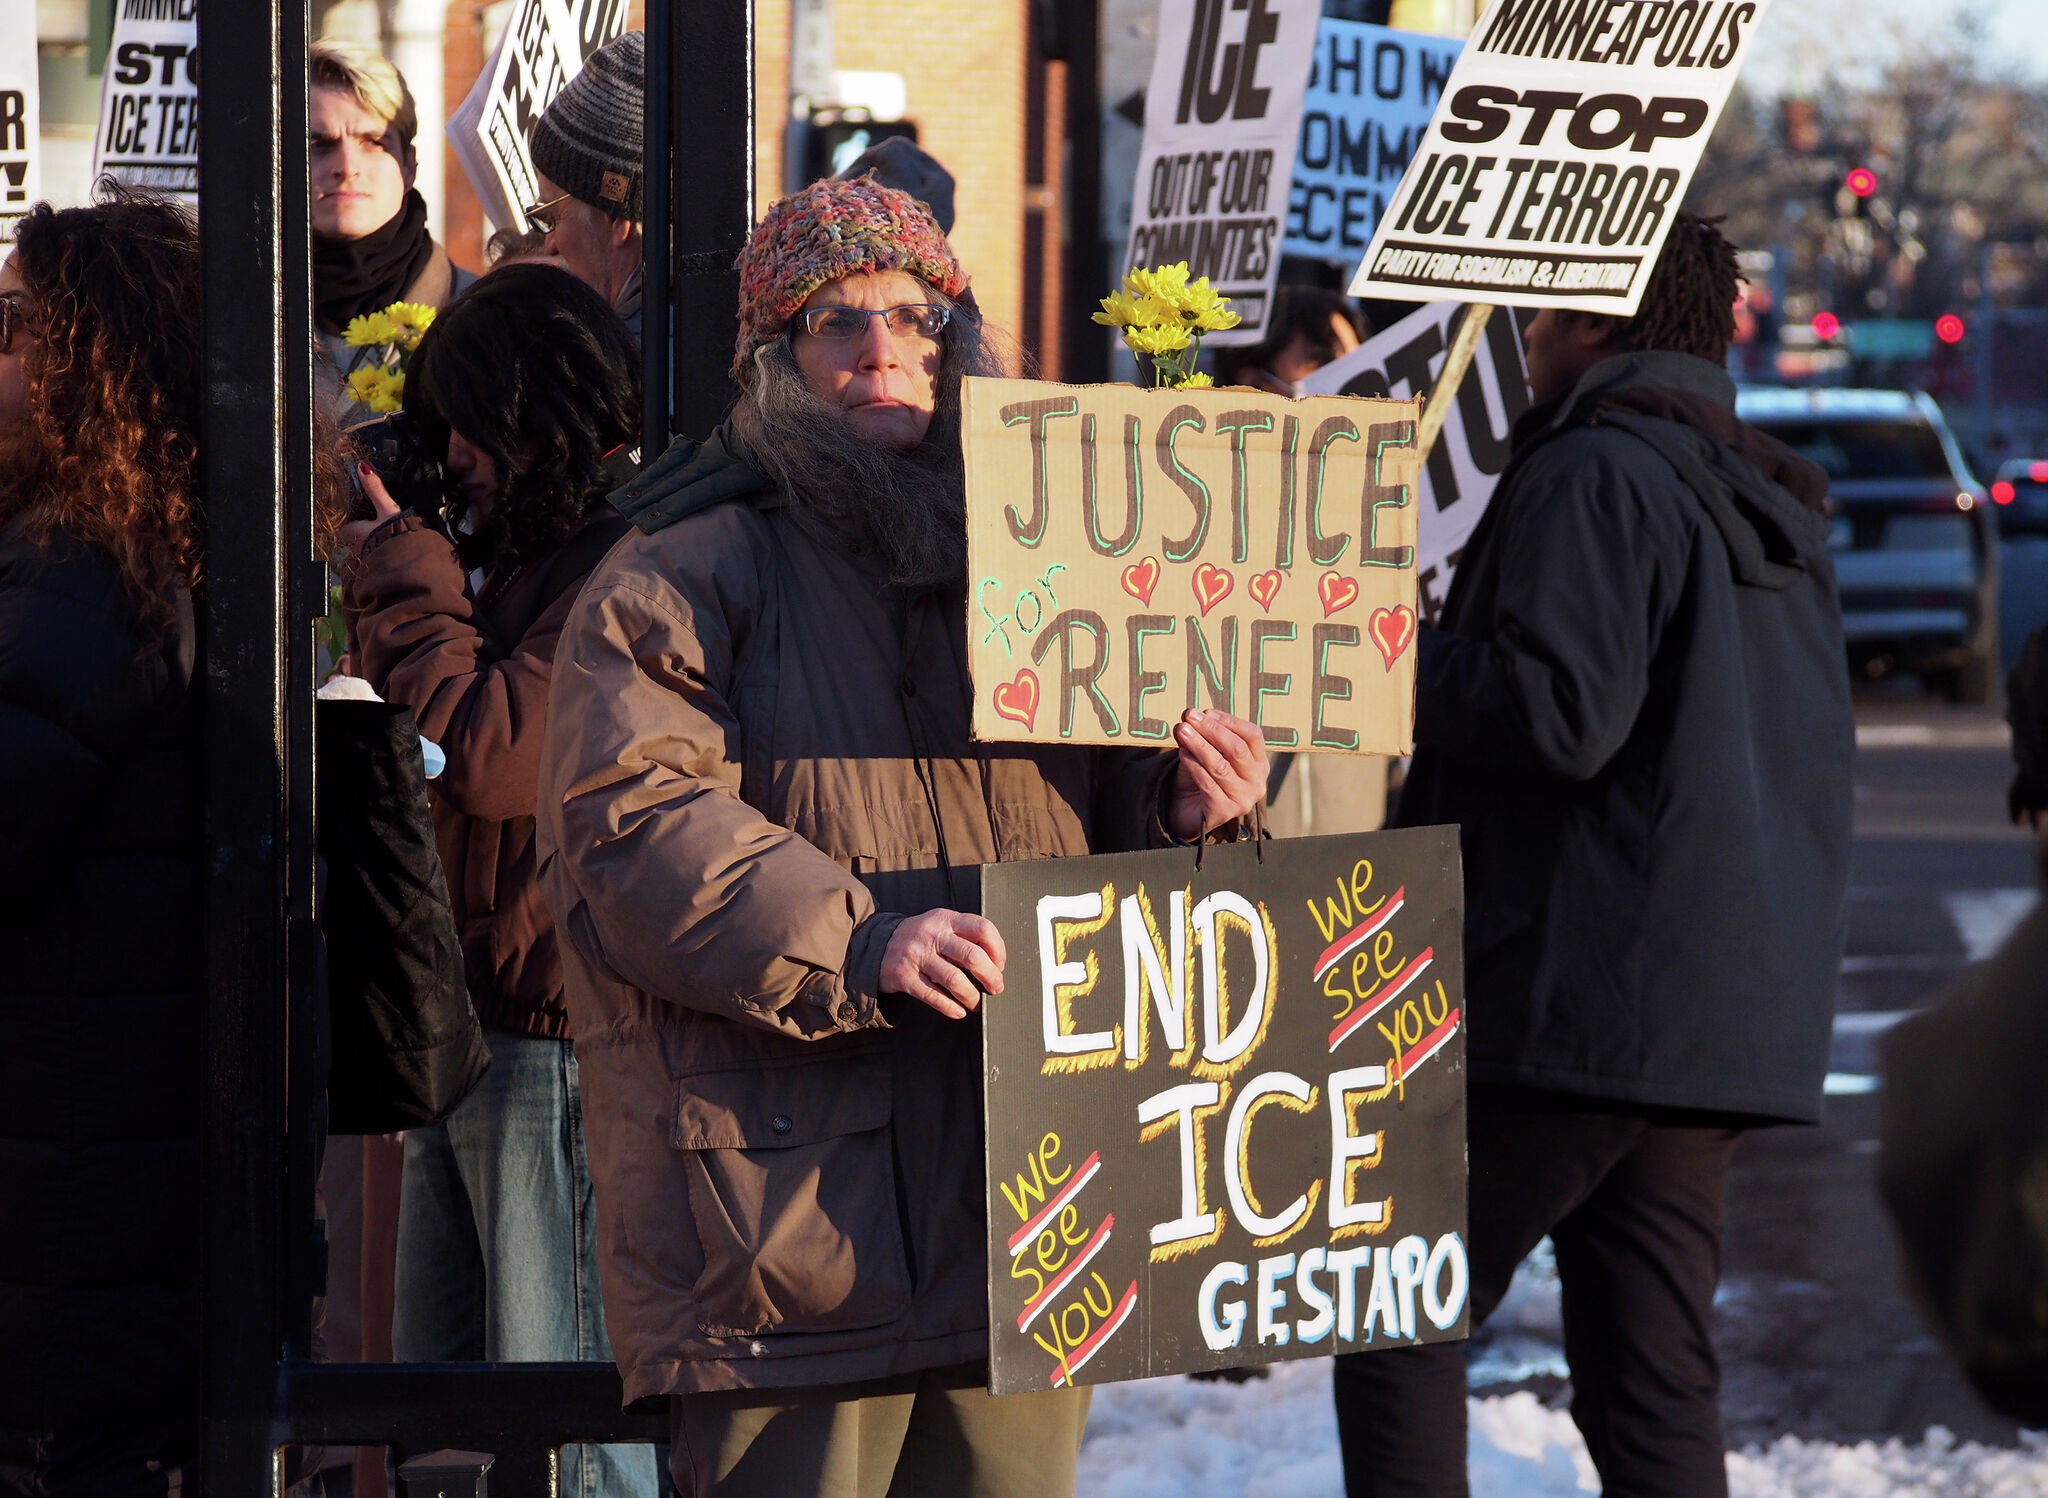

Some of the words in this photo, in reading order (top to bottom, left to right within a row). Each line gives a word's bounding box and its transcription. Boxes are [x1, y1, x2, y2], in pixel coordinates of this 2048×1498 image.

[1176, 0, 1281, 124] ICE
[1477, 0, 1756, 69] MINNEAPOLIS
[105, 94, 152, 154] ICE
[1440, 85, 1709, 153] STOP
[1148, 154, 1192, 219] OUT
[1189, 151, 1223, 216] OF
[1220, 149, 1275, 214] OUR
[1394, 153, 1497, 237] ICE
[1485, 158, 1681, 247] TERROR
[1372, 247, 1433, 278] PARTY
[1421, 252, 1462, 281] FOR
[1453, 255, 1539, 286] SOCIALISM
[1530, 261, 1555, 288] &
[1550, 261, 1637, 291] LIBERATION
[1000, 396, 1417, 570] JUSTICE
[976, 563, 1068, 659] for
[1031, 609, 1361, 750] RENEE
[1036, 881, 1279, 1081] END
[1138, 1058, 1395, 1263] ICE
[1198, 1232, 1469, 1350] GESTAPO
